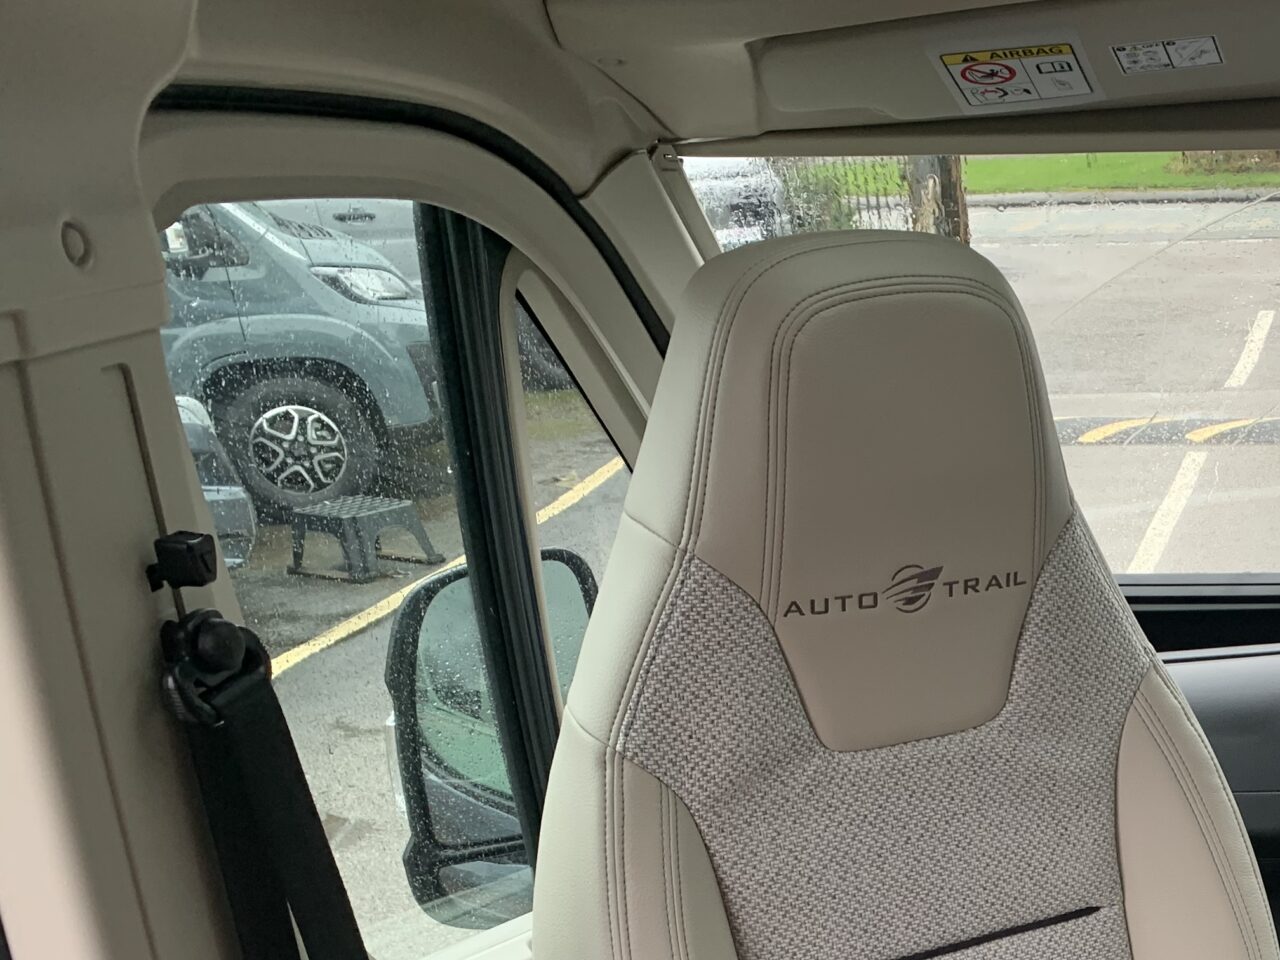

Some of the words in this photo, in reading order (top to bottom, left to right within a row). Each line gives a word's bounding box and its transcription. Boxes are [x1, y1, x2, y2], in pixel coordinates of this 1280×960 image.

[989, 45, 1064, 60] AIRBAG
[783, 591, 879, 618] AUTO
[942, 570, 1028, 598] TRAIL
